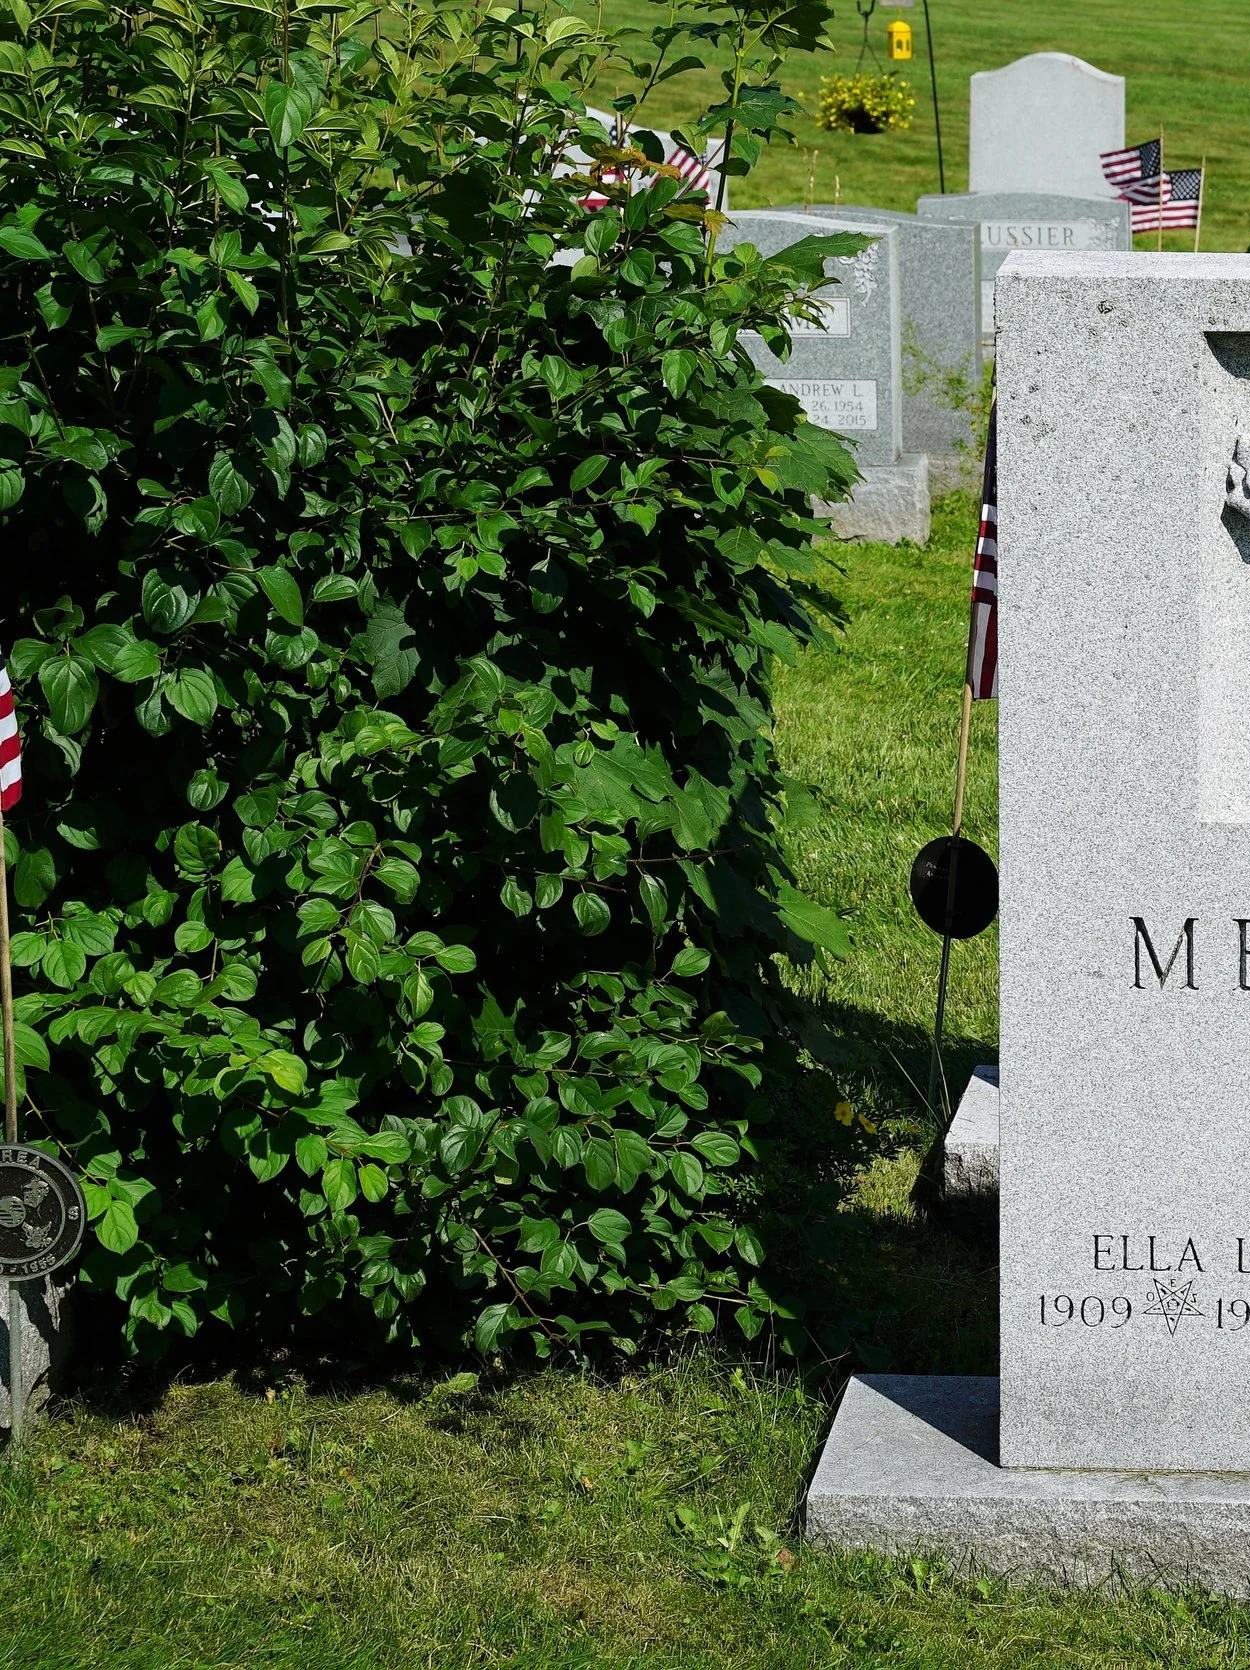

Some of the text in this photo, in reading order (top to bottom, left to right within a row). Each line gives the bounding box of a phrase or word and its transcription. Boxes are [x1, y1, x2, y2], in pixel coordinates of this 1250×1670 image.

[980, 225, 1075, 247] USSIER
[780, 383, 842, 397] ANDREW
[834, 401, 863, 412] 1954
[838, 414, 867, 426] 2015
[0, 1149, 41, 1169] REA
[1092, 1234, 1206, 1273] ELLA
[1037, 1294, 1133, 1328] 1909
